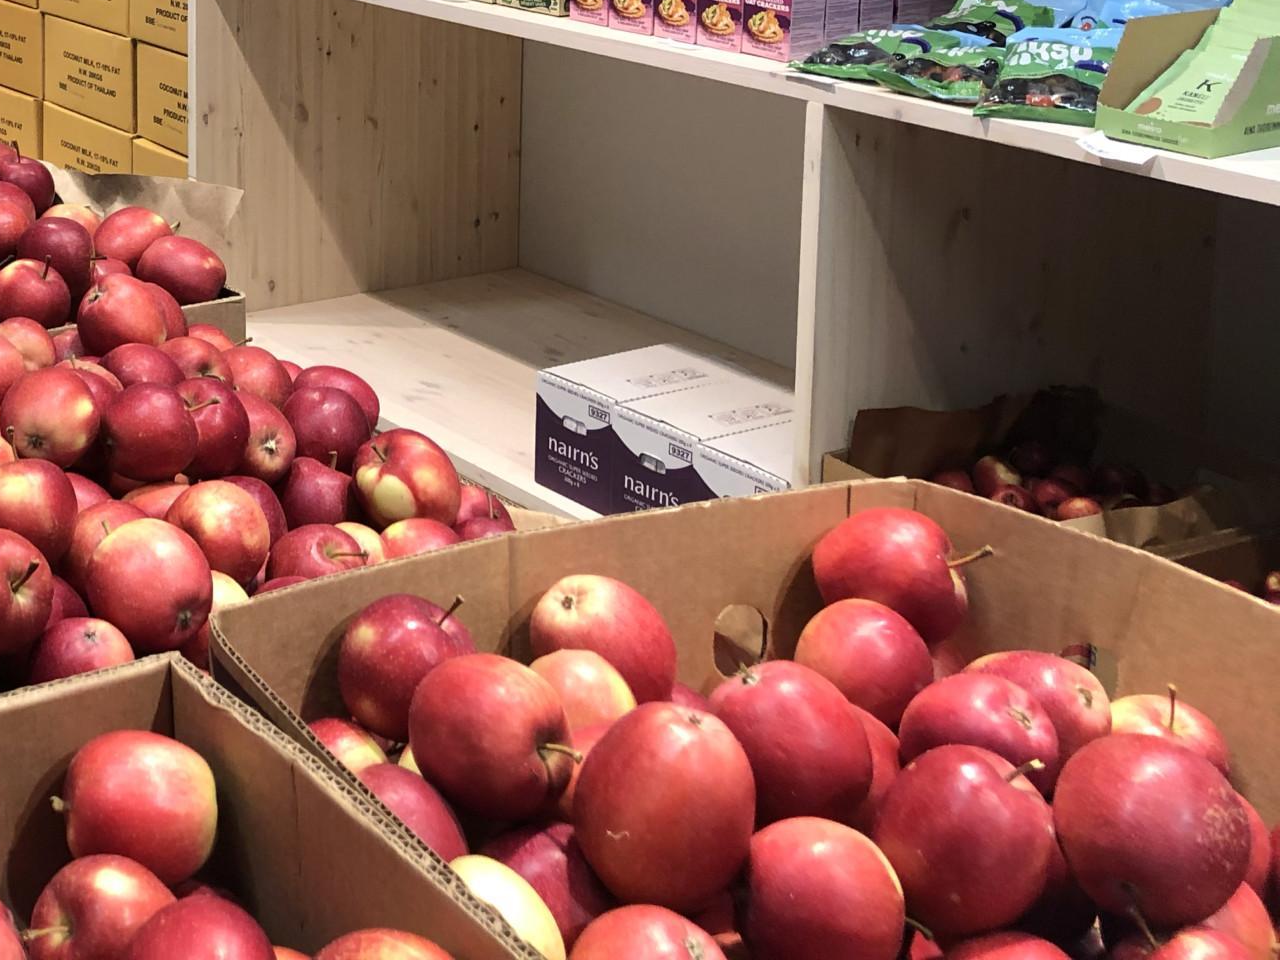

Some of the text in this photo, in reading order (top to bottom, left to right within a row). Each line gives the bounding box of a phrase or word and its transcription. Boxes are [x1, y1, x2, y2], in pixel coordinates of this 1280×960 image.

[155, 8, 180, 21] PRODUCT
[757, 0, 790, 12] CRACKERS
[63, 50, 82, 62] COCONUT
[111, 66, 120, 75] FAT
[67, 74, 86, 87] PRODUCT
[94, 84, 116, 98] THAILAND
[590, 407, 608, 421] 9327
[548, 436, 599, 470] nairn's
[671, 445, 690, 459] 9327
[558, 466, 587, 484] CRACKERS
[624, 473, 680, 507] nairn's
